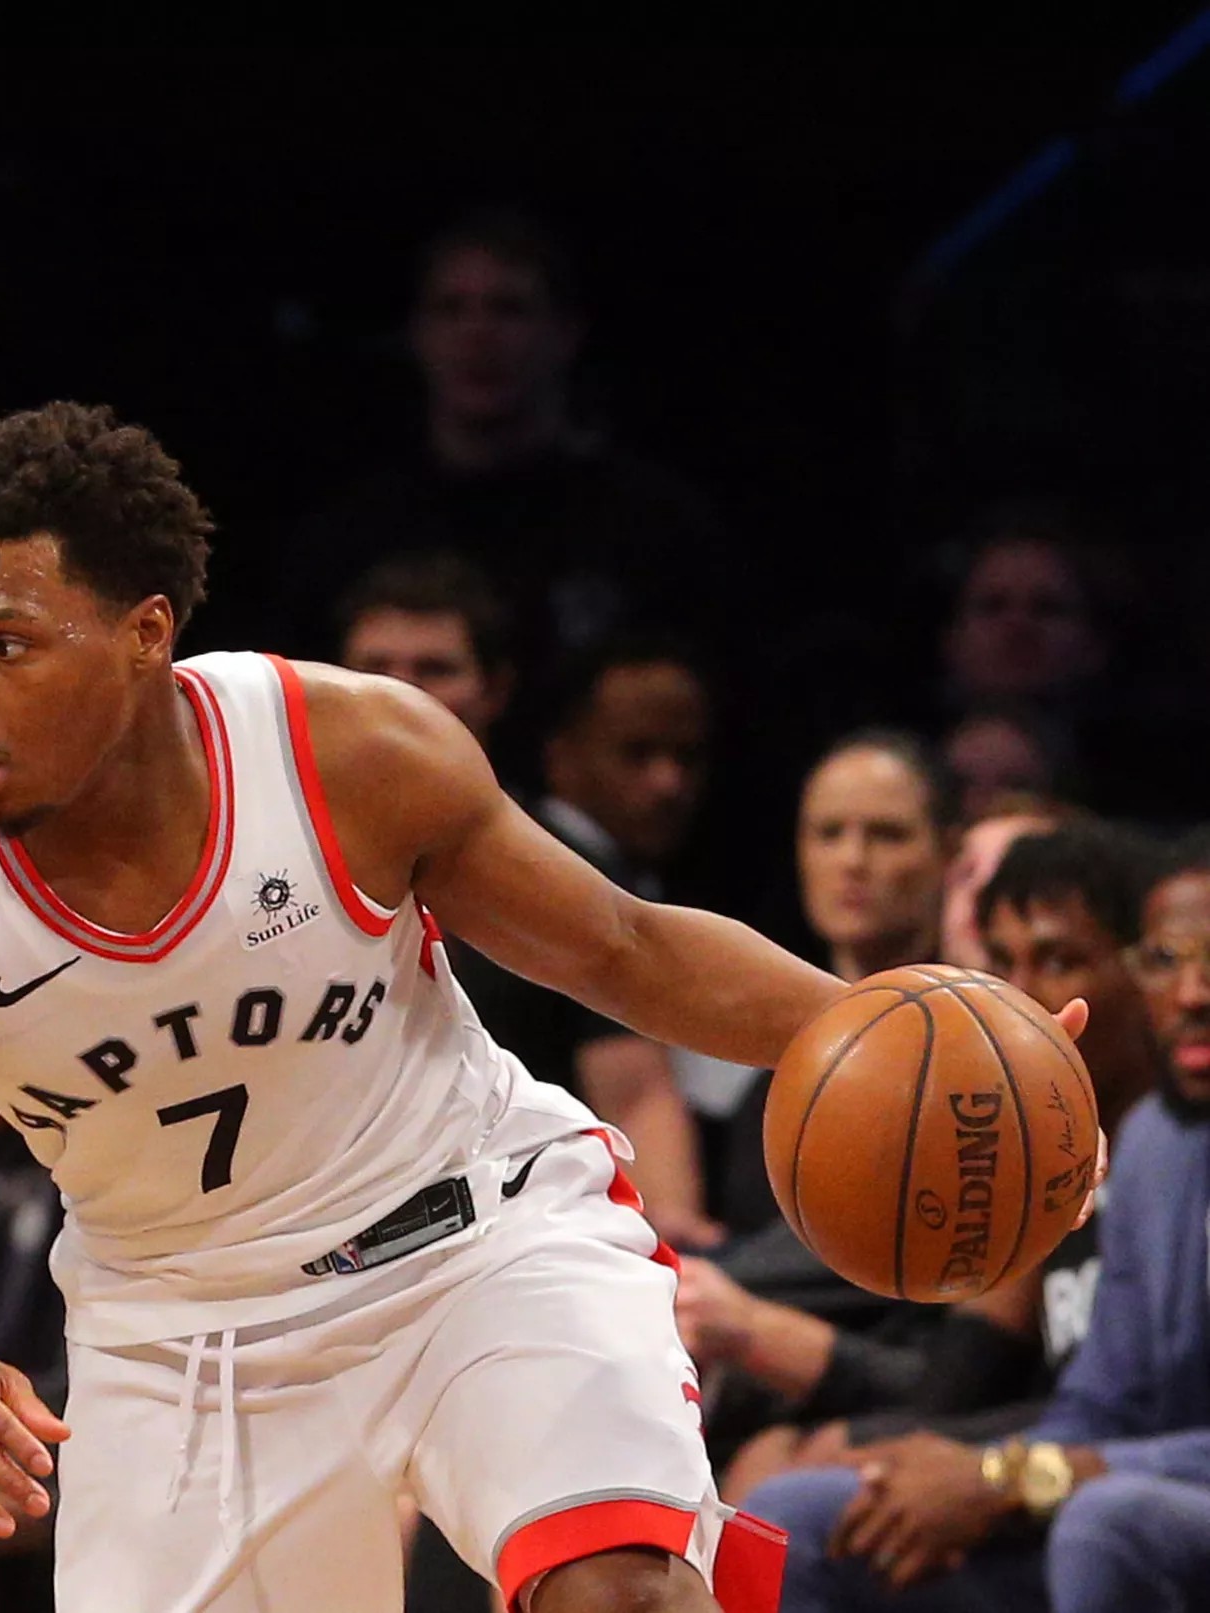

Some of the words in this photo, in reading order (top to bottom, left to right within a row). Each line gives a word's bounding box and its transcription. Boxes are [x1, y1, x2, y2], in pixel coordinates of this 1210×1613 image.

[246, 923, 284, 947] Sun
[286, 903, 320, 929] Life
[156, 1083, 250, 1194] 7
